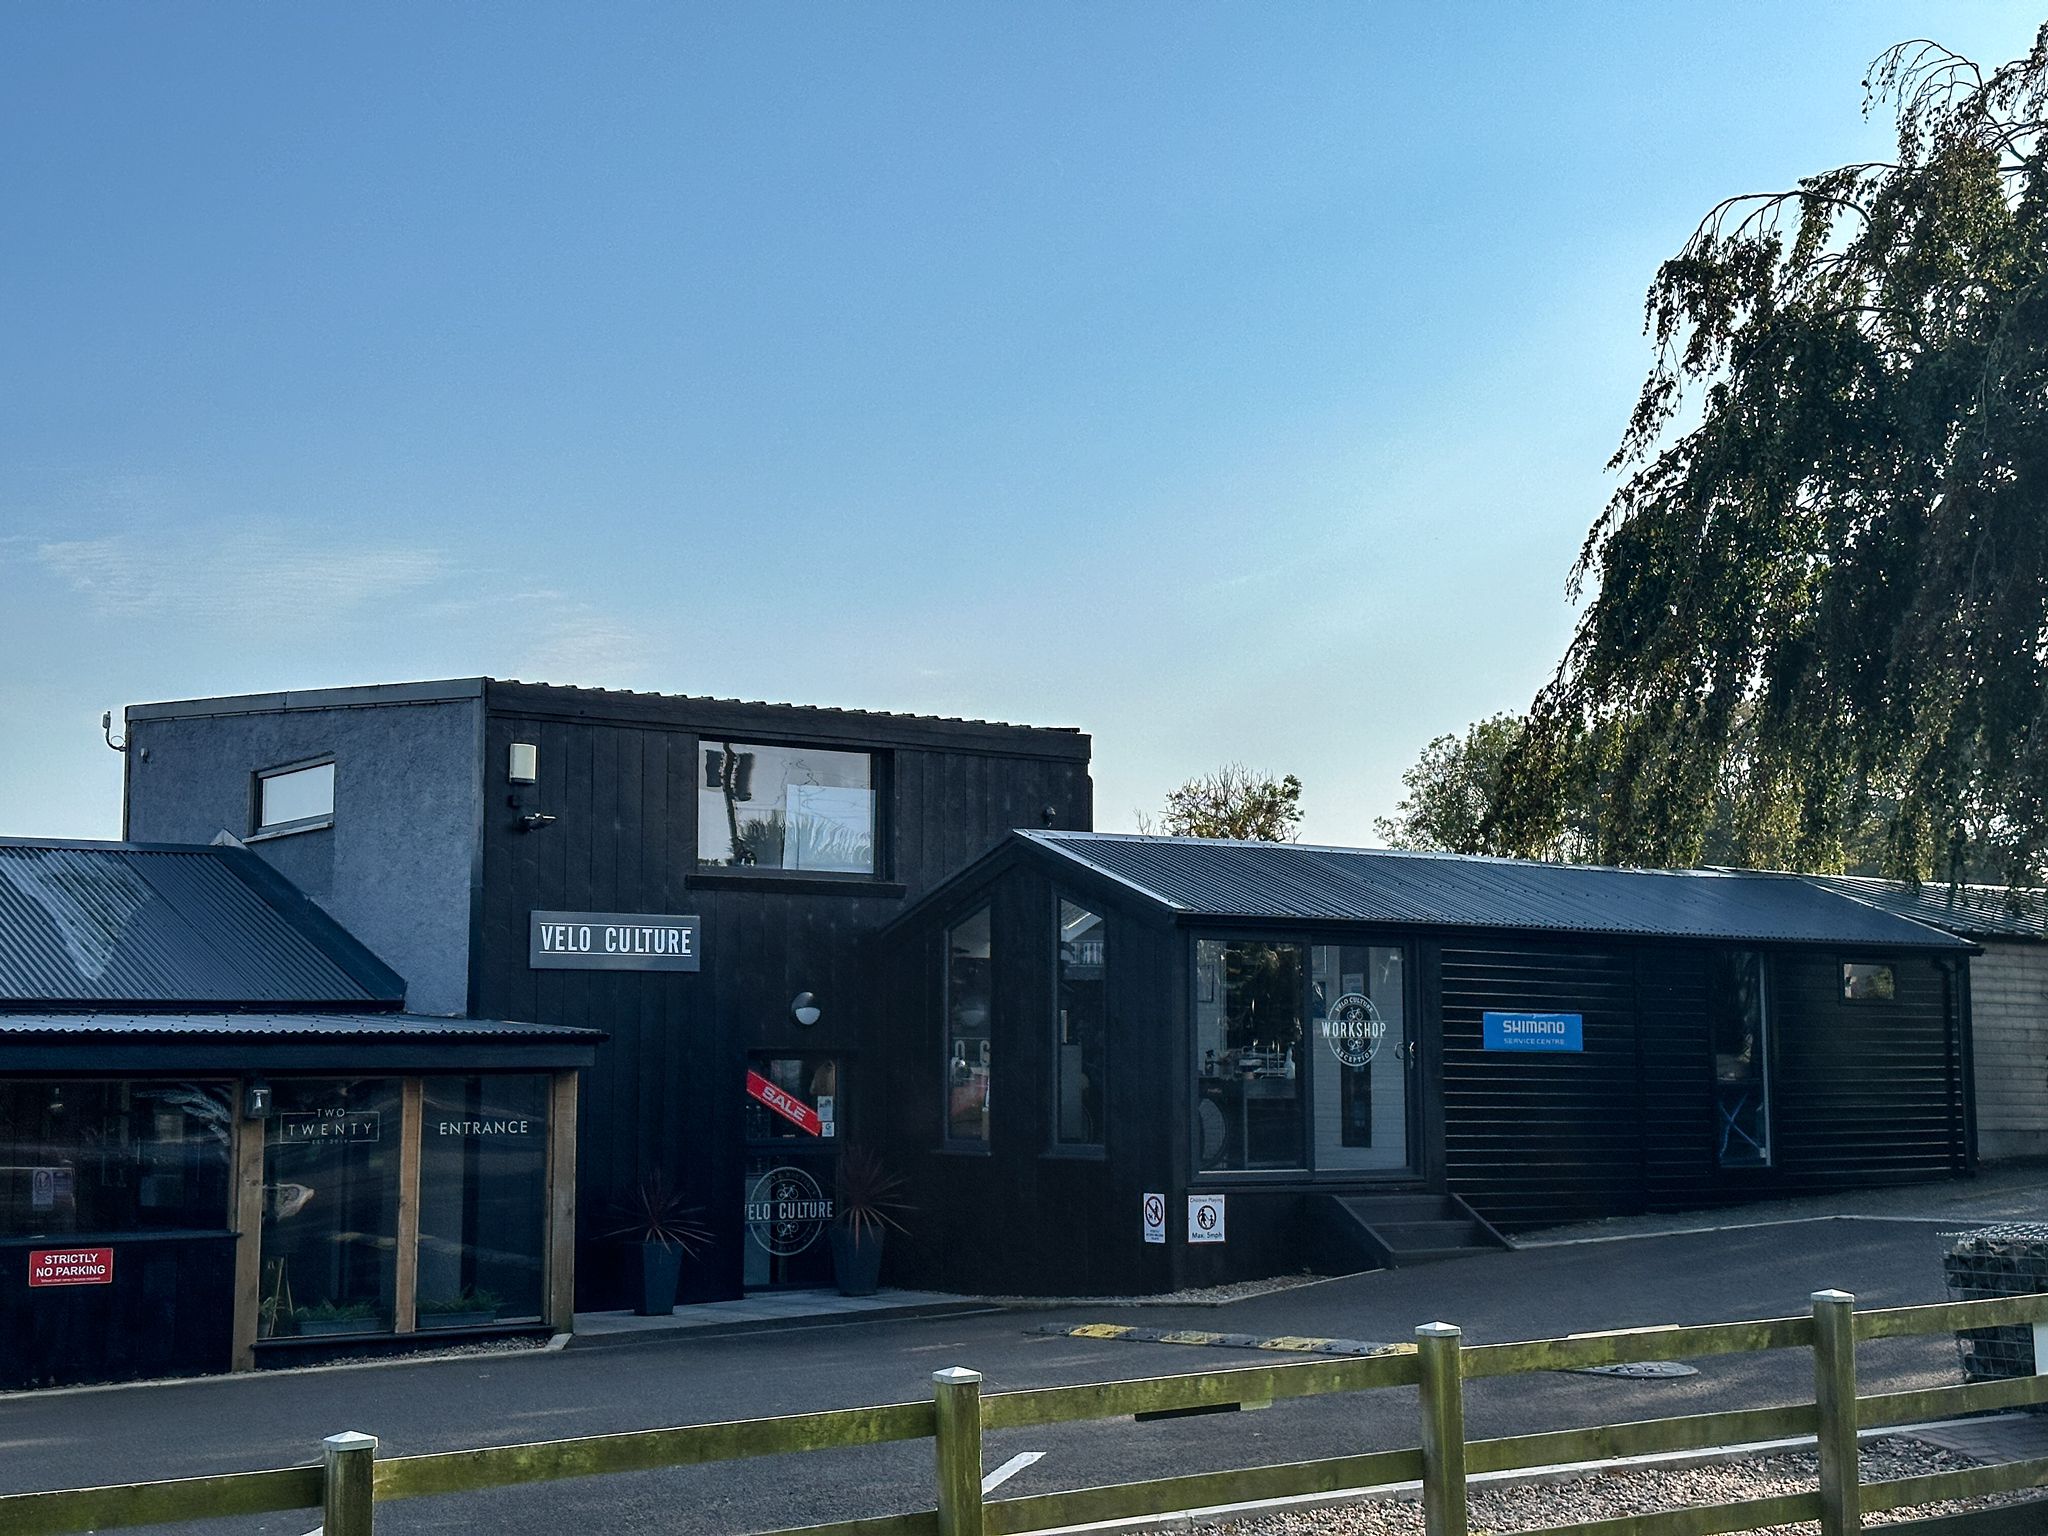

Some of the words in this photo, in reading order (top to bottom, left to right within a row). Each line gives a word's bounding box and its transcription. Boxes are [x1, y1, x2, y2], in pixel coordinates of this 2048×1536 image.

[541, 926, 591, 952] VELO
[605, 927, 692, 954] CULTURE
[1334, 999, 1349, 1012] VELO
[1348, 996, 1374, 1013] CULTURE
[1321, 1021, 1387, 1037] WORKSHOP
[1503, 1020, 1565, 1034] SHIMANO
[1336, 1047, 1374, 1063] RECEPTION
[762, 1086, 807, 1122] SALE
[316, 1108, 346, 1118] TWO
[288, 1123, 372, 1136] TWENTY
[440, 1120, 528, 1135] ENTRANCE
[779, 1201, 834, 1219] CULTURE
[1206, 1231, 1223, 1239] 5mph
[45, 1253, 98, 1265] STRICTLY
[36, 1267, 53, 1277] NO
[56, 1265, 106, 1276] PARKING
